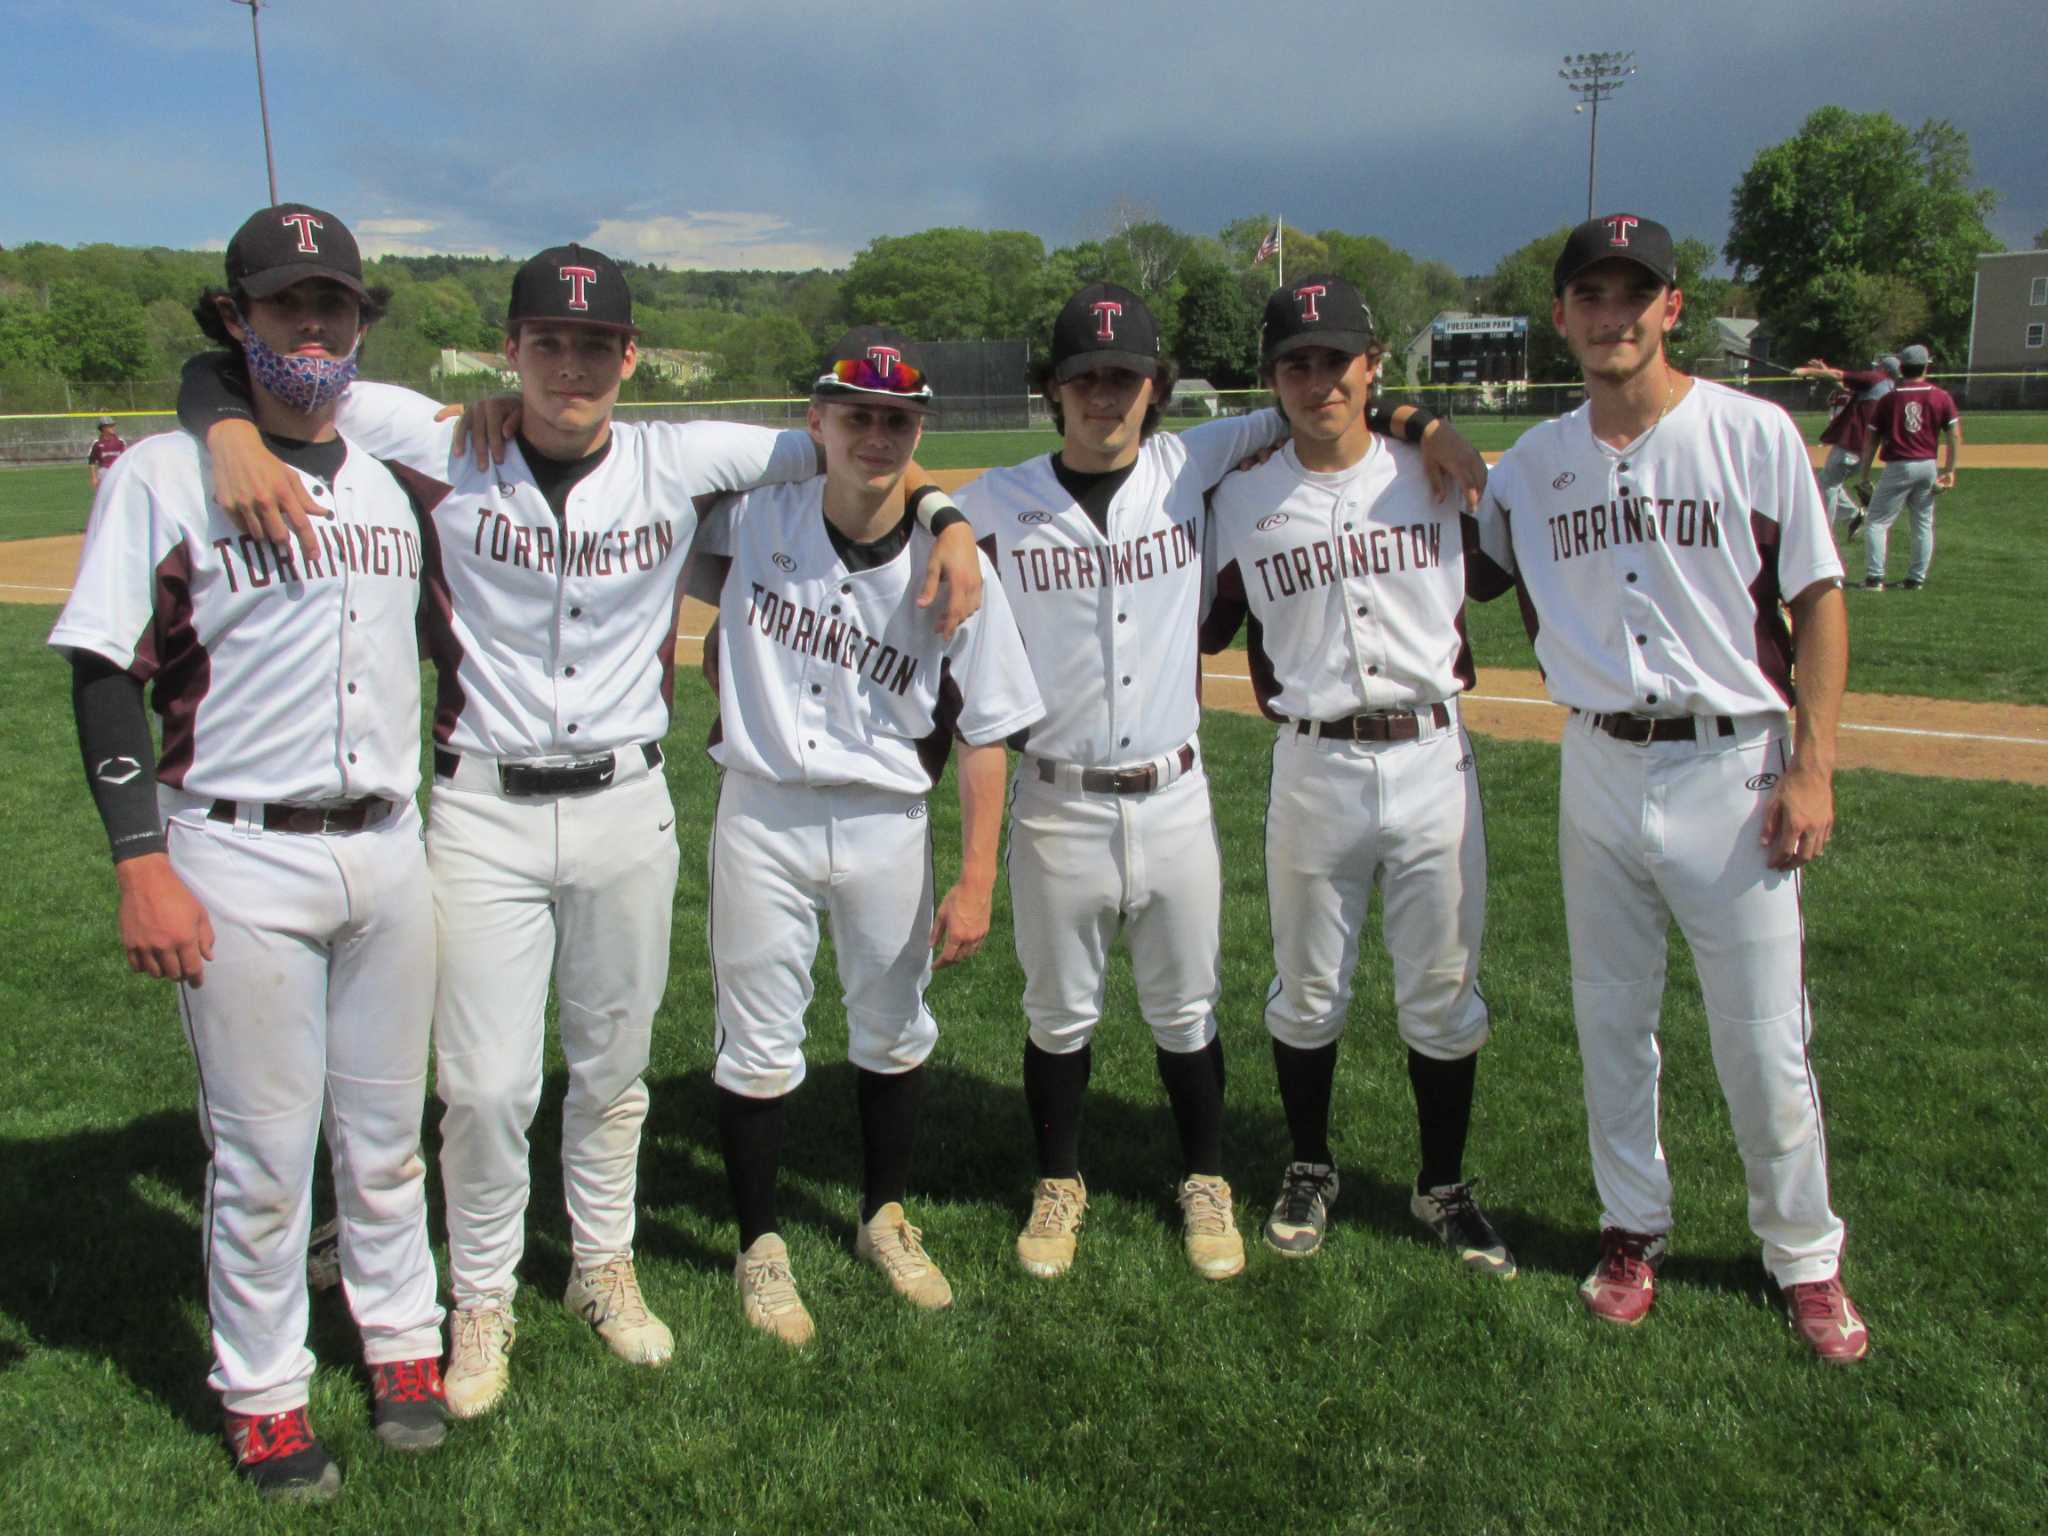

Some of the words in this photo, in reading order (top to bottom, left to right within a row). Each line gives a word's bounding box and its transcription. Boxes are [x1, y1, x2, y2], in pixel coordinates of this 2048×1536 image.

[282, 213, 323, 254] T
[1604, 215, 1638, 247] T
[559, 266, 597, 311] T
[1293, 284, 1326, 321] T
[1089, 301, 1122, 341] T
[867, 346, 901, 378] T
[474, 507, 674, 577] TORRINGTON
[1548, 496, 1720, 562] TORRINGTON
[1012, 516, 1198, 593] TORRINGTON
[1254, 522, 1442, 602] TORRINGTON
[747, 580, 919, 697] TORRINGTON
